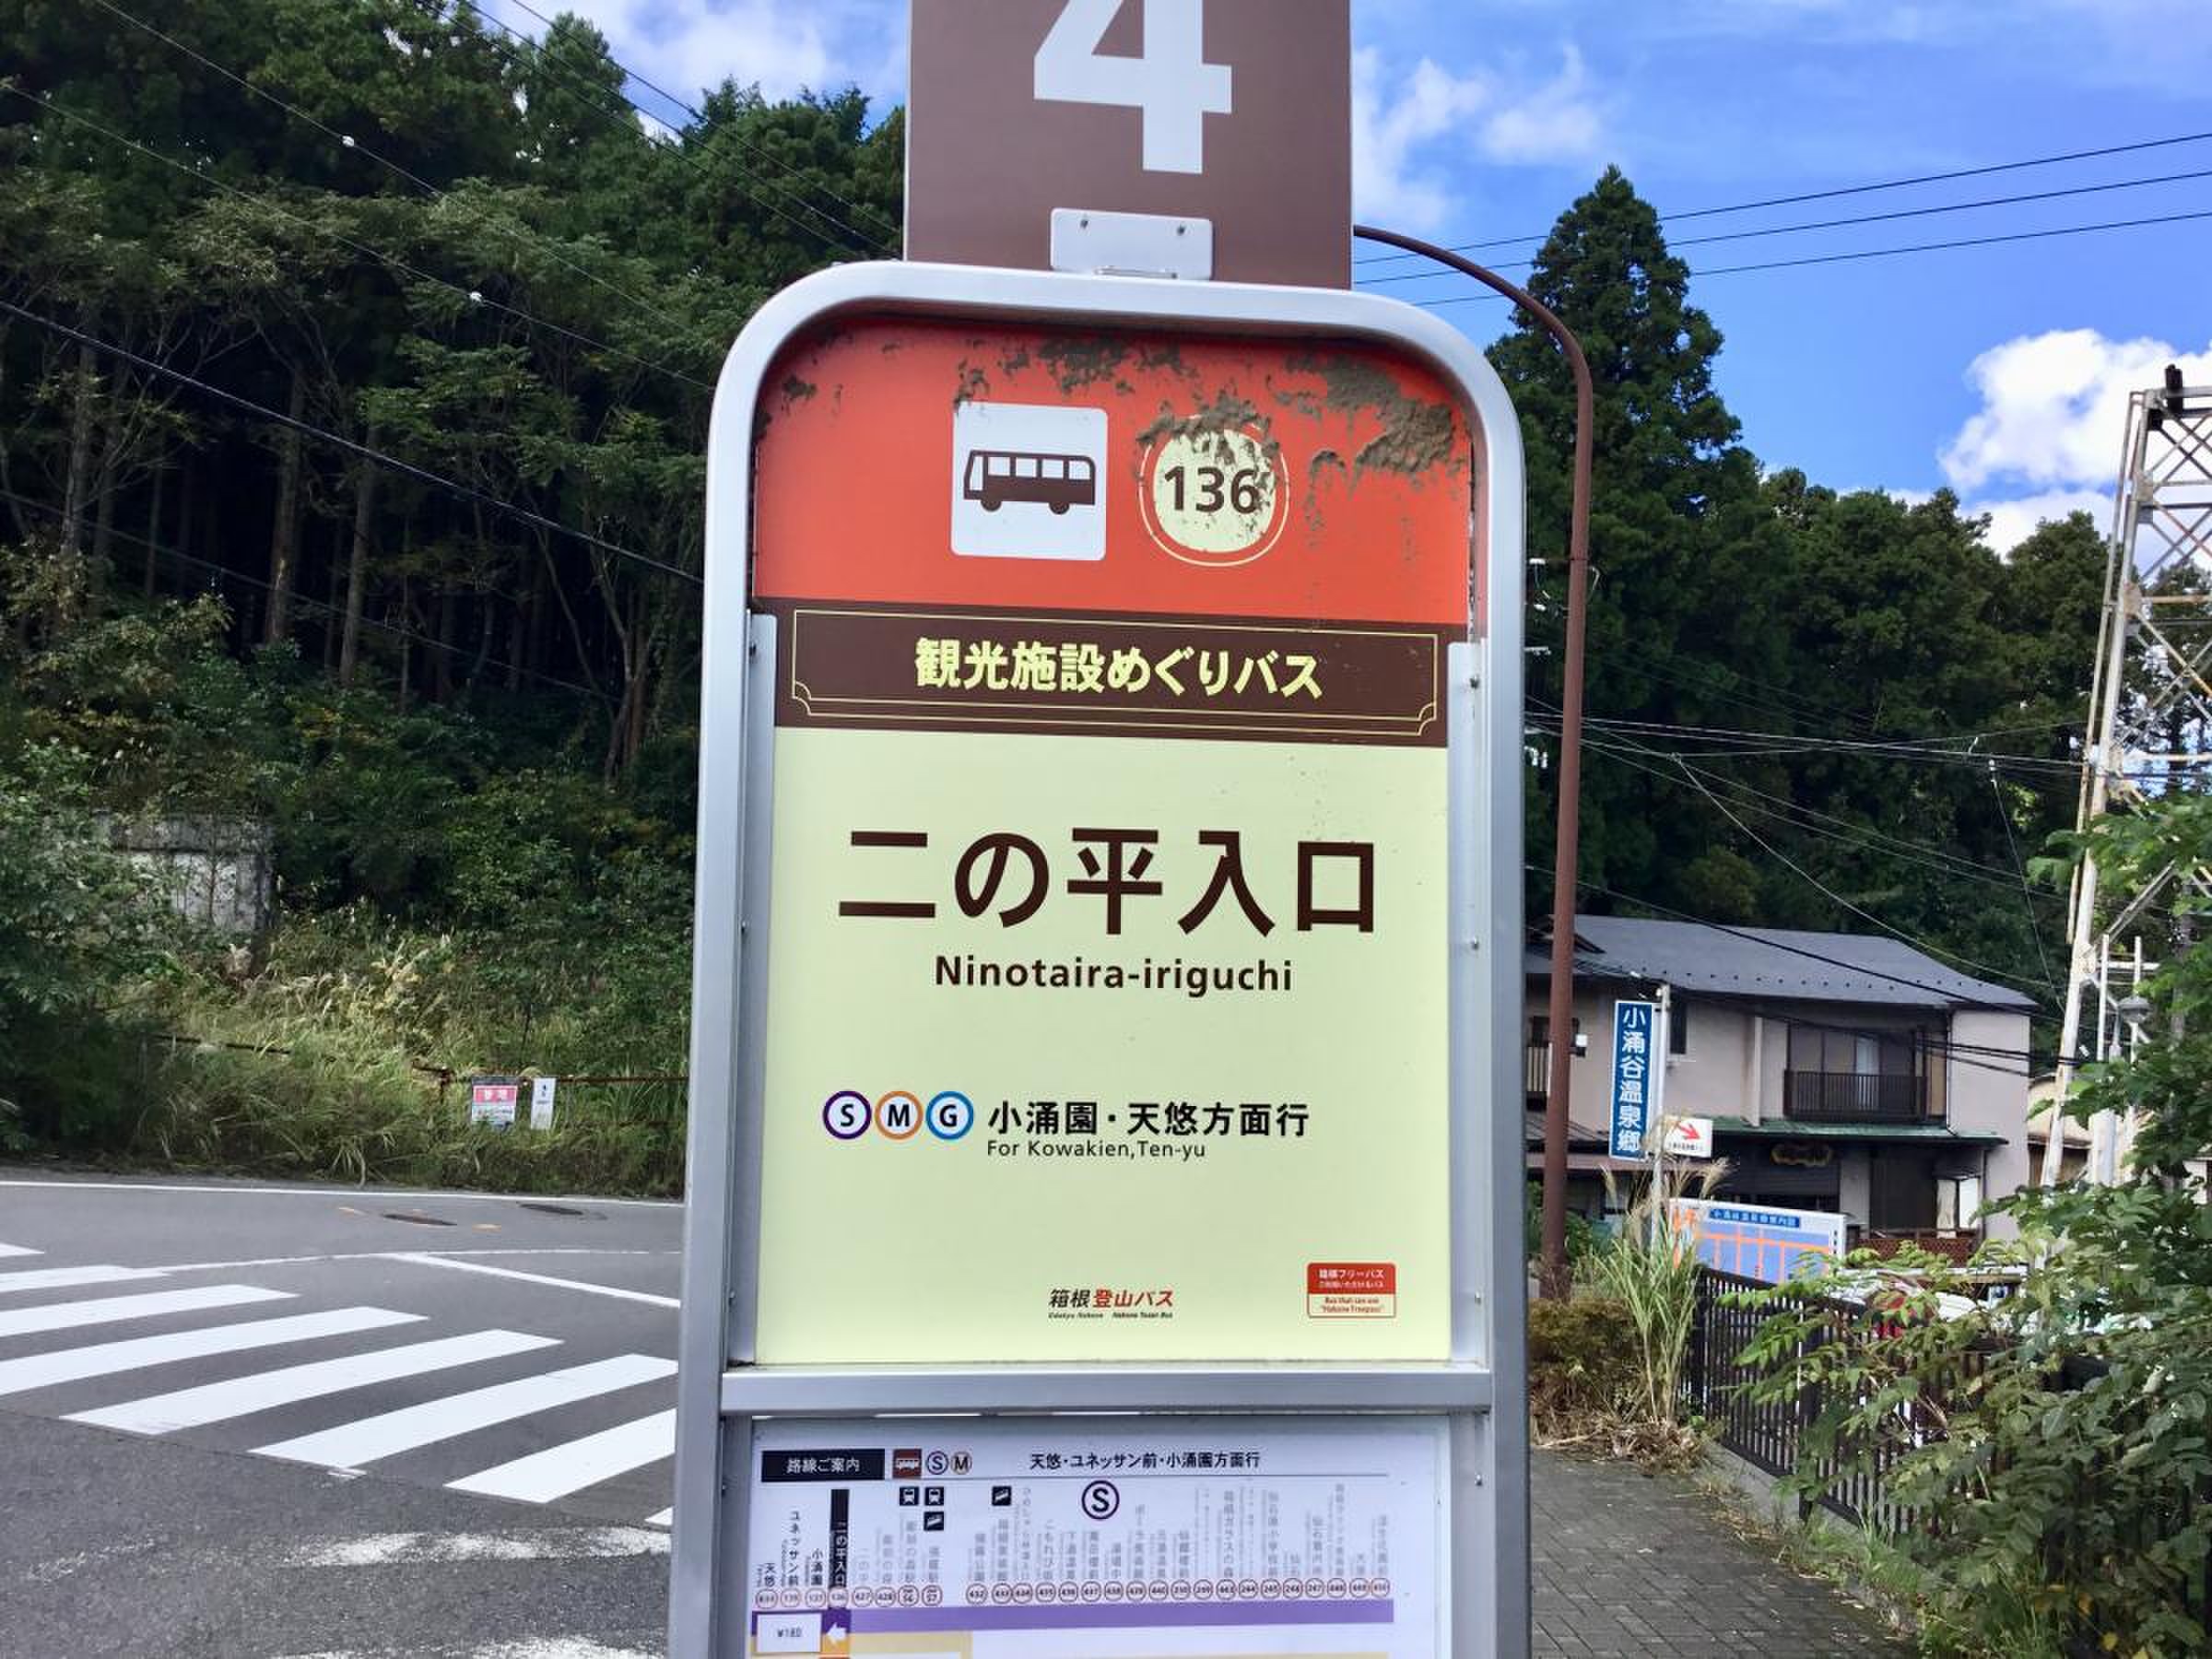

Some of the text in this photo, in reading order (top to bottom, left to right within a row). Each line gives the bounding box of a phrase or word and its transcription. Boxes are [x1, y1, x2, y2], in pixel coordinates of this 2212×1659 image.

[1034, 0, 1231, 173] 4
[1164, 465, 1259, 514] 136
[915, 637, 1324, 699] 観光施設めぐりバス
[840, 828, 1373, 936] 二の平入口
[935, 955, 1291, 997] Ninotaira-iriguchi
[1618, 1006, 1646, 1152] 小涌谷温泉郷
[840, 1104, 958, 1127] S M G
[987, 1101, 1310, 1136] 小涌園・天悠方面行
[987, 1139, 1206, 1161] For Kowakien,Ten-yu
[1048, 1288, 1173, 1309] 箱根登山バス
[786, 1458, 861, 1474] 路線ご案内
[1090, 1488, 1112, 1513] S
[834, 1521, 848, 1585] 二の平入口
